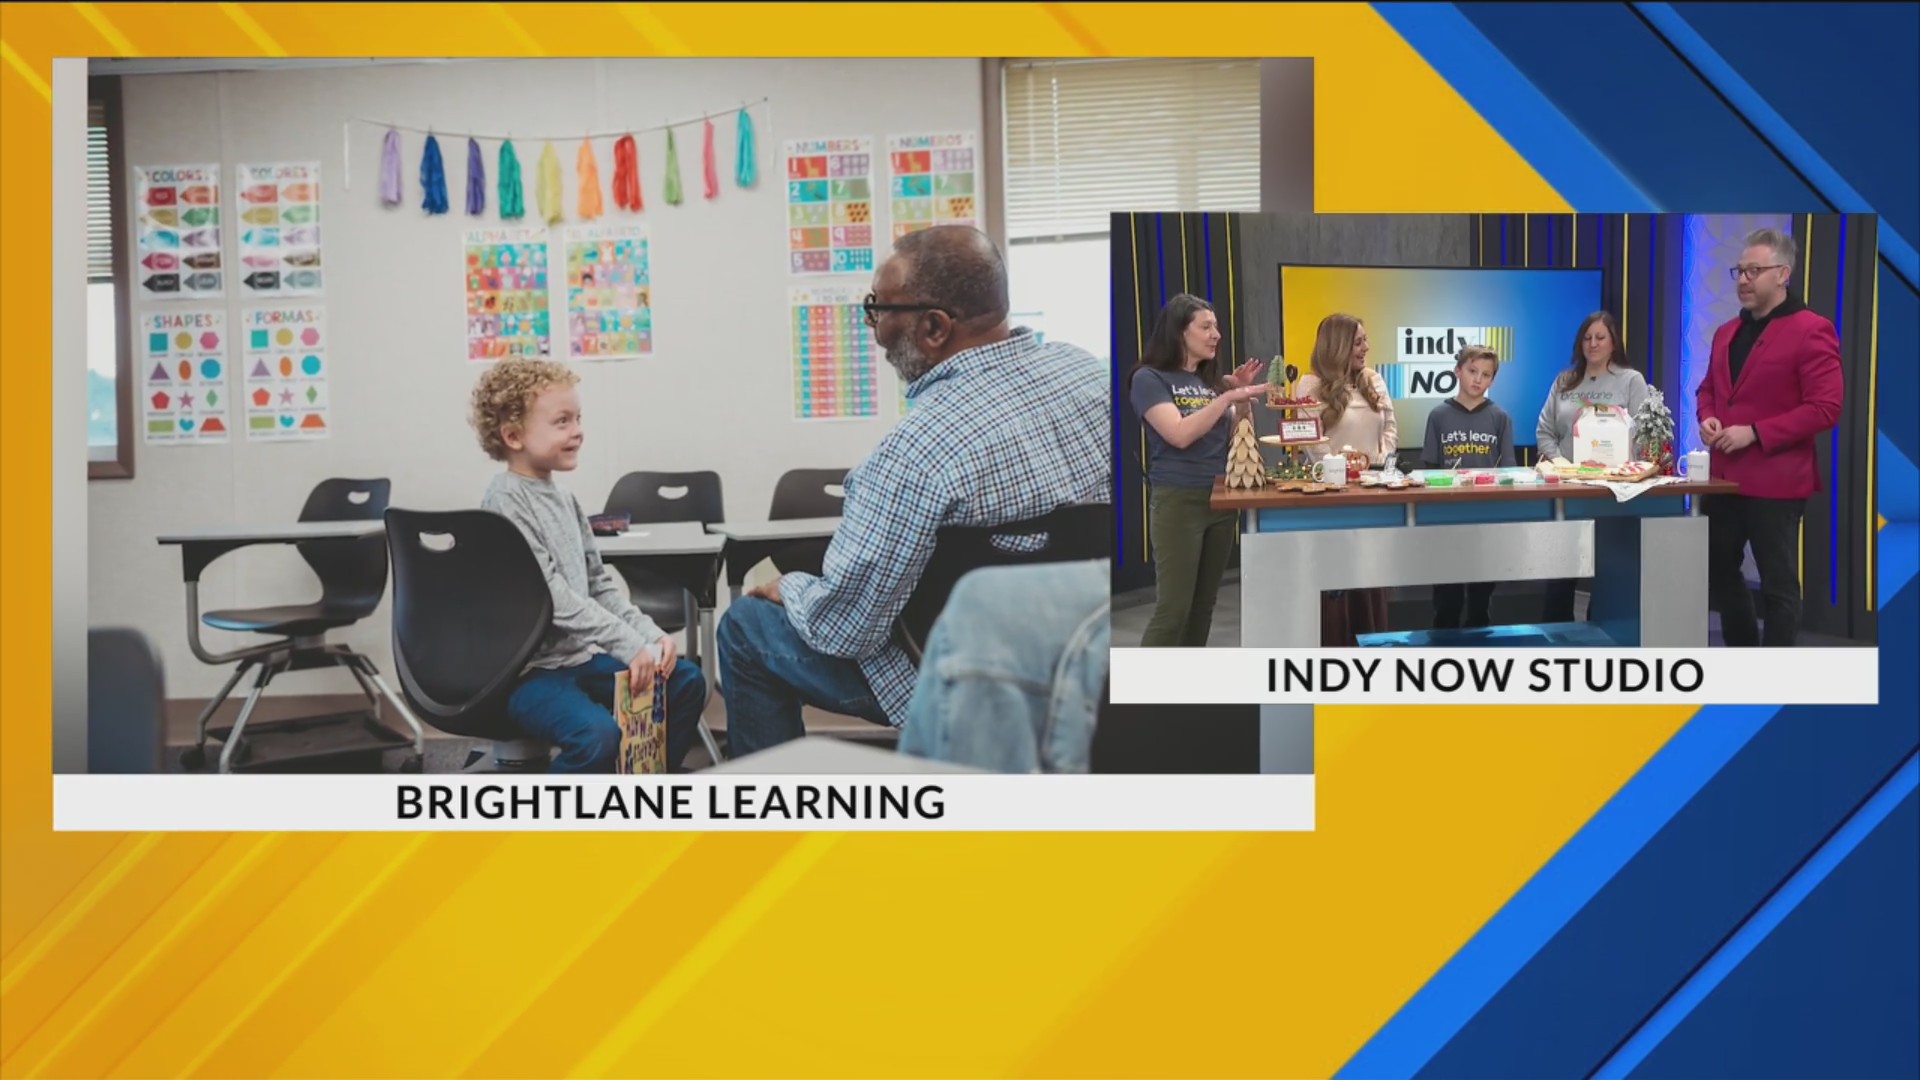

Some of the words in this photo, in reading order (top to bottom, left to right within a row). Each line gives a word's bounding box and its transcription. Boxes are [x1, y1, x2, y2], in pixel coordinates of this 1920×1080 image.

[796, 140, 860, 153] NUMBERS
[152, 170, 203, 183] COLORS
[939, 174, 948, 189] 7
[791, 181, 800, 195] 2
[836, 180, 845, 194] 7
[834, 227, 845, 240] 9
[154, 314, 213, 328] SHAPES
[256, 310, 314, 325] FORMAS
[1405, 328, 1475, 360] indy
[1411, 370, 1457, 394] NO
[1172, 384, 1199, 395] Let's
[1441, 430, 1467, 443] Let's
[1469, 429, 1498, 444] learn
[1443, 441, 1491, 456] together
